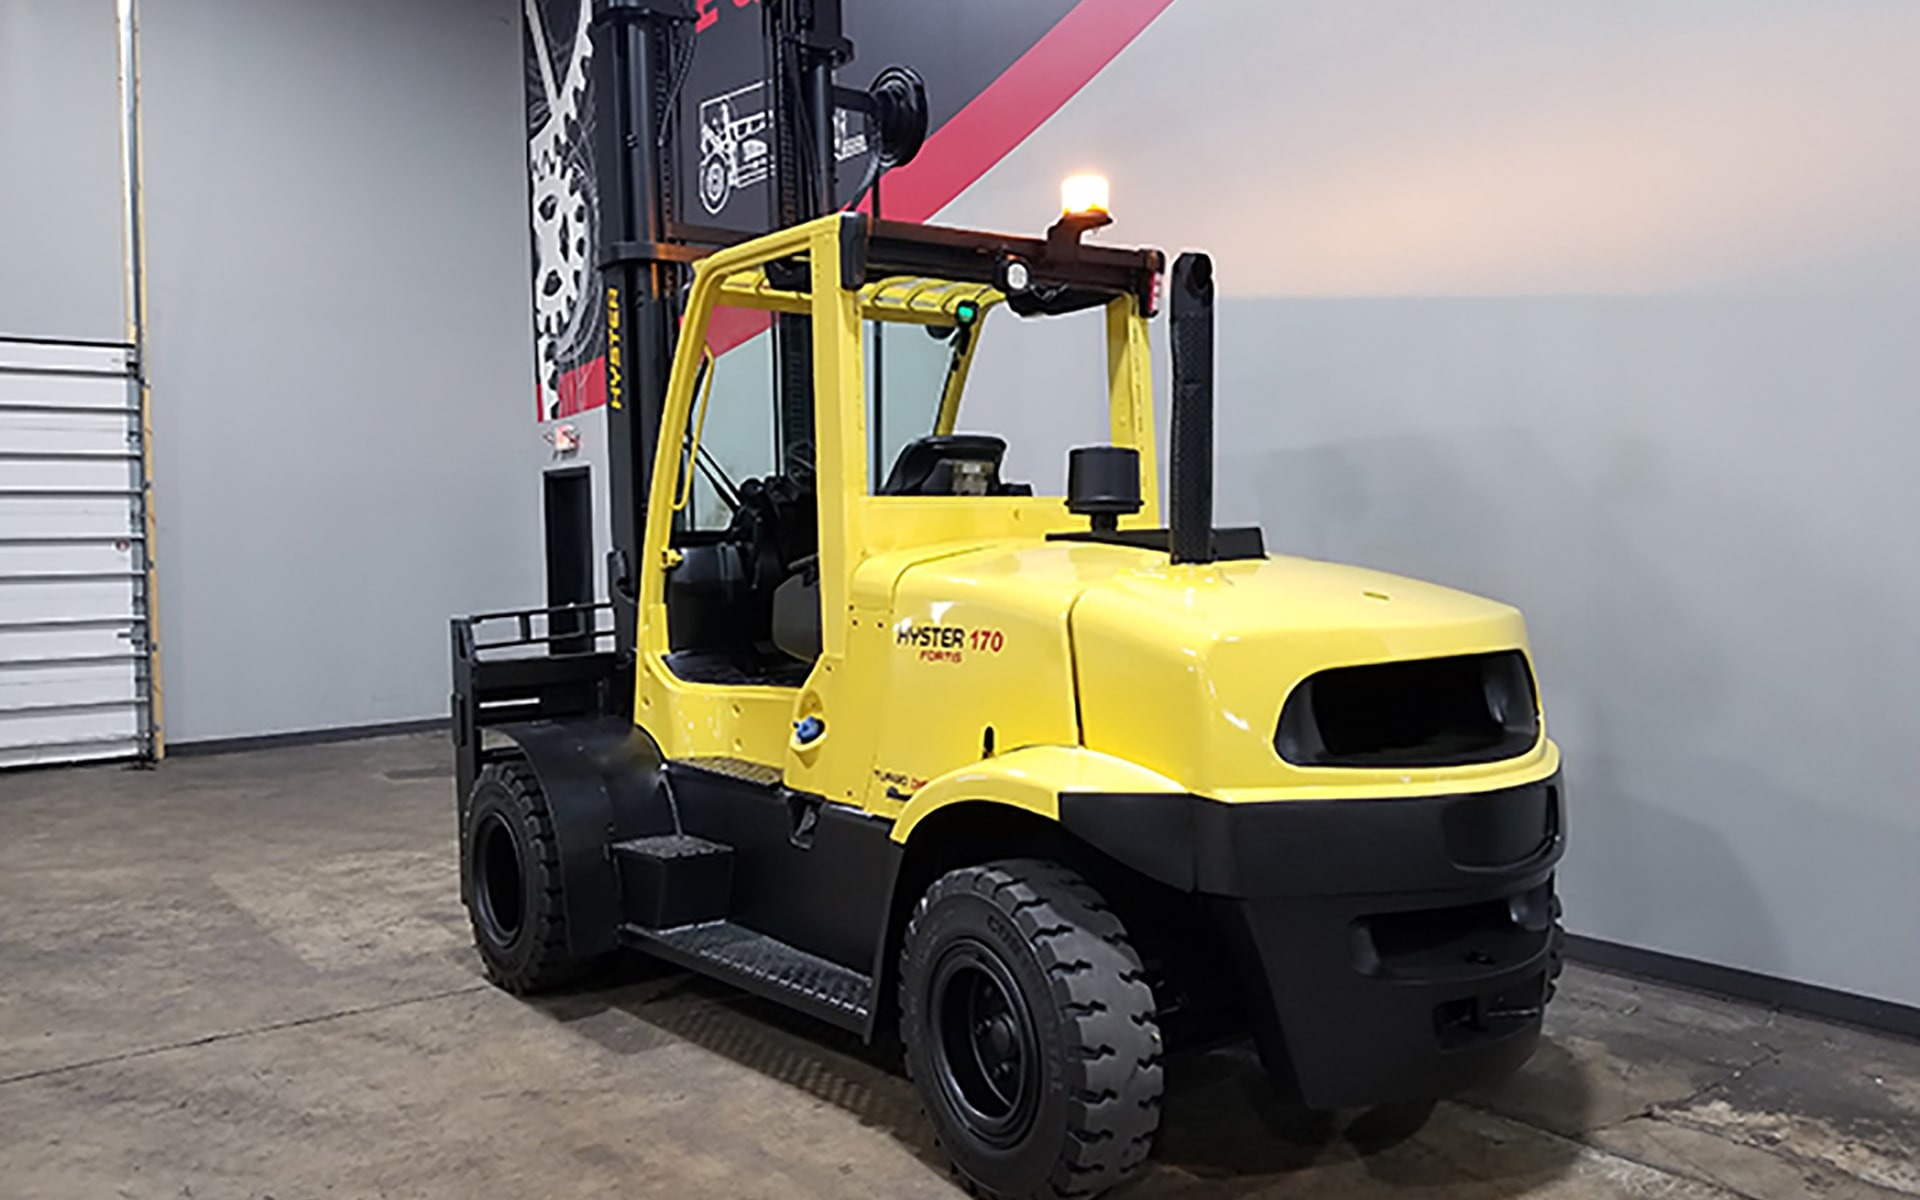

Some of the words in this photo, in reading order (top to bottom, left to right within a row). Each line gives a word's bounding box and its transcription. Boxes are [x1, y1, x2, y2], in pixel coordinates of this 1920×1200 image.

[608, 287, 621, 410] HYSTER
[896, 626, 965, 649] HYSTER
[970, 629, 1004, 653] 170
[919, 650, 962, 664] FORTIS
